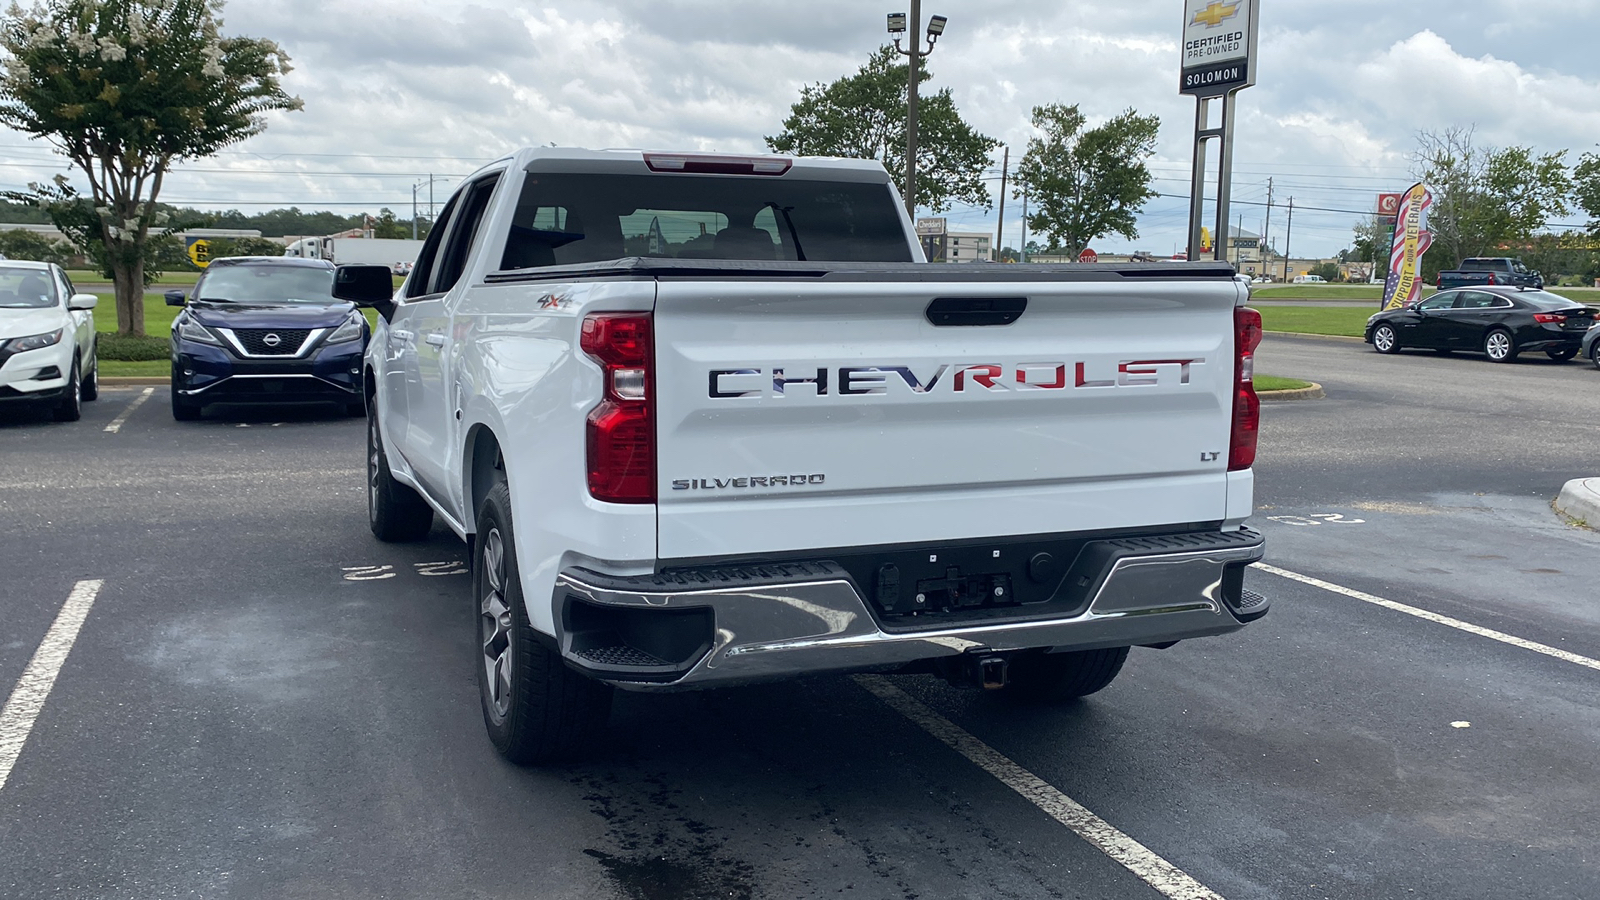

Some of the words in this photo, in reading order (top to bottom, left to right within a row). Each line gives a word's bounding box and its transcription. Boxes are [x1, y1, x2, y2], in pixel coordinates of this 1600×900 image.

[1186, 31, 1243, 50] CERTIFIED
[1187, 42, 1240, 59] PRE-OWNED
[1186, 67, 1239, 86] SOLOMON
[1406, 194, 1422, 240] VETERANS
[1080, 255, 1097, 263] STOP
[1406, 248, 1415, 262] OUR
[708, 357, 1206, 399] CHEVROLET
[1200, 451, 1220, 461] LT
[672, 473, 825, 490] SILVERADO
